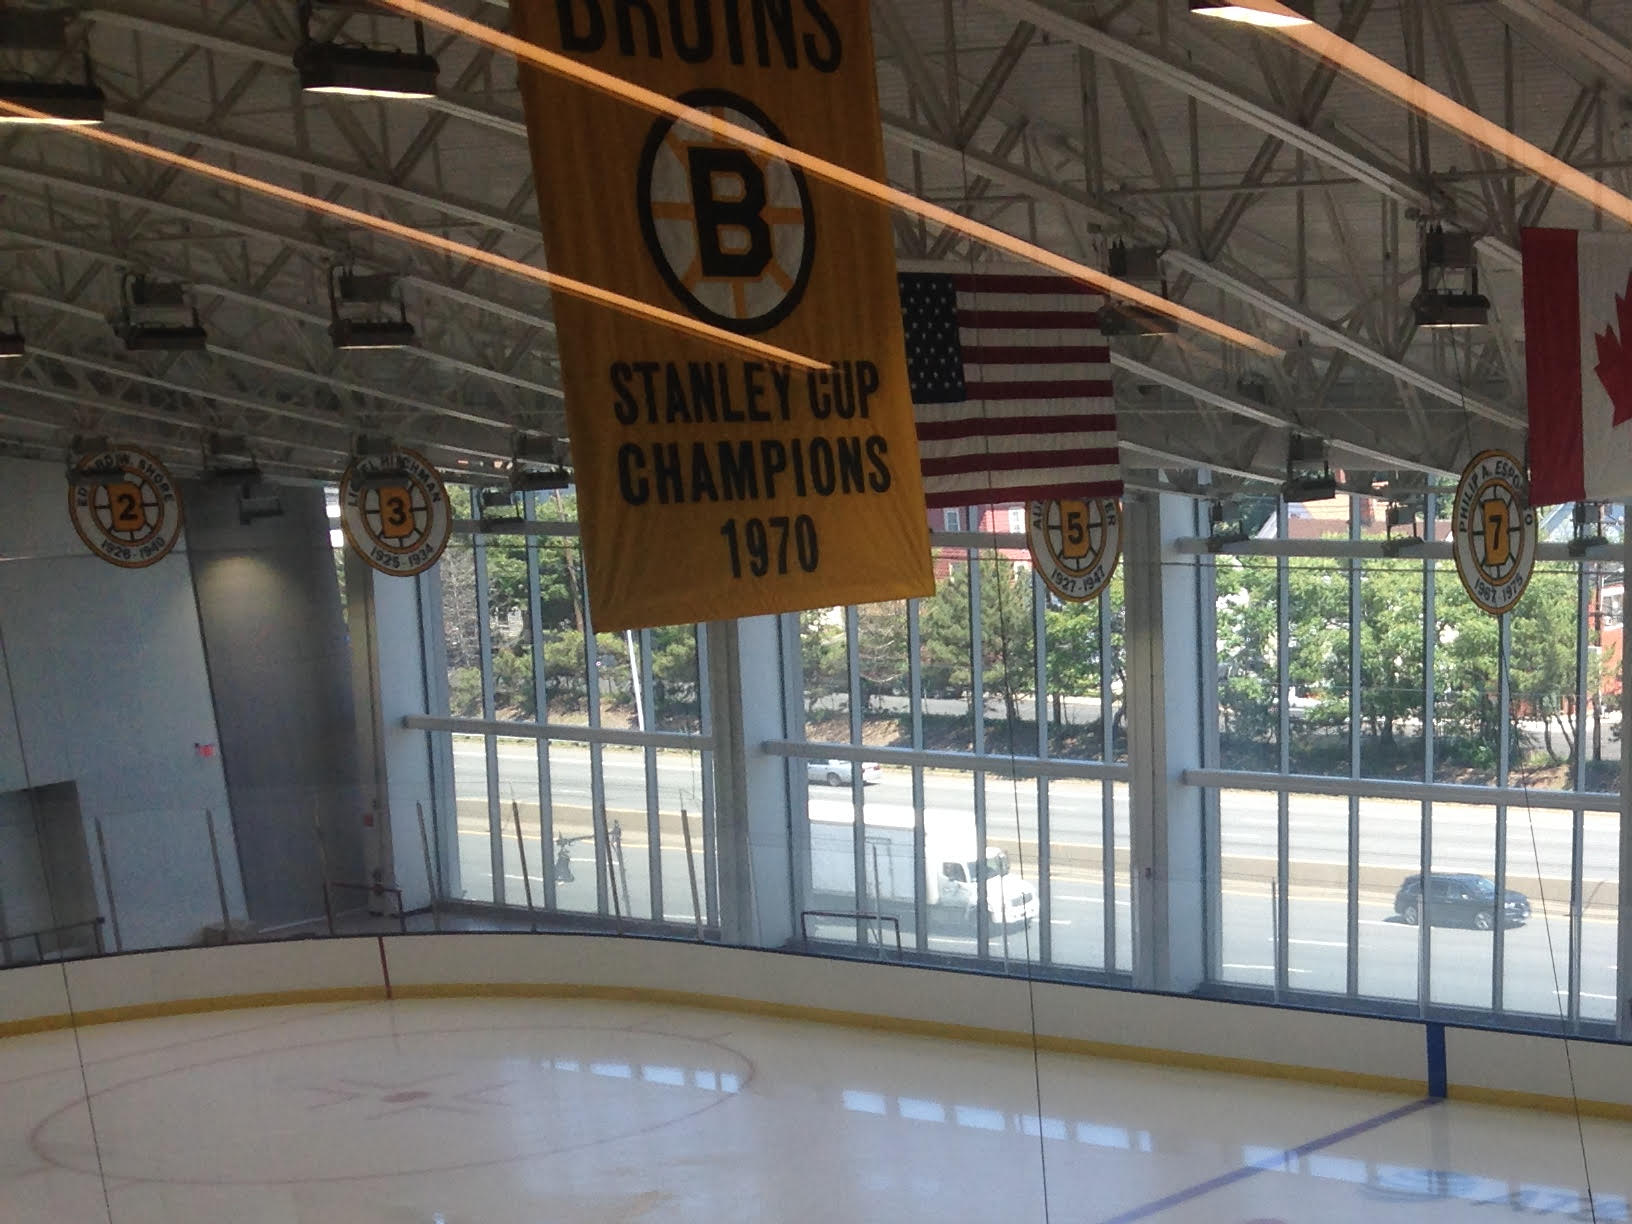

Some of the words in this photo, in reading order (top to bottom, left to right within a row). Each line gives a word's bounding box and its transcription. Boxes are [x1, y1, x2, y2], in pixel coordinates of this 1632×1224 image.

[687, 146, 773, 278] B
[609, 360, 791, 425] STANLEY
[807, 360, 879, 420] CUP
[617, 435, 892, 506] CHAMPIONS
[118, 494, 138, 520] 2
[386, 497, 406, 525] 3
[1068, 511, 1085, 544] 5
[1459, 473, 1479, 532] PHILIP
[1489, 514, 1503, 550] 7
[720, 514, 819, 579] 1970
